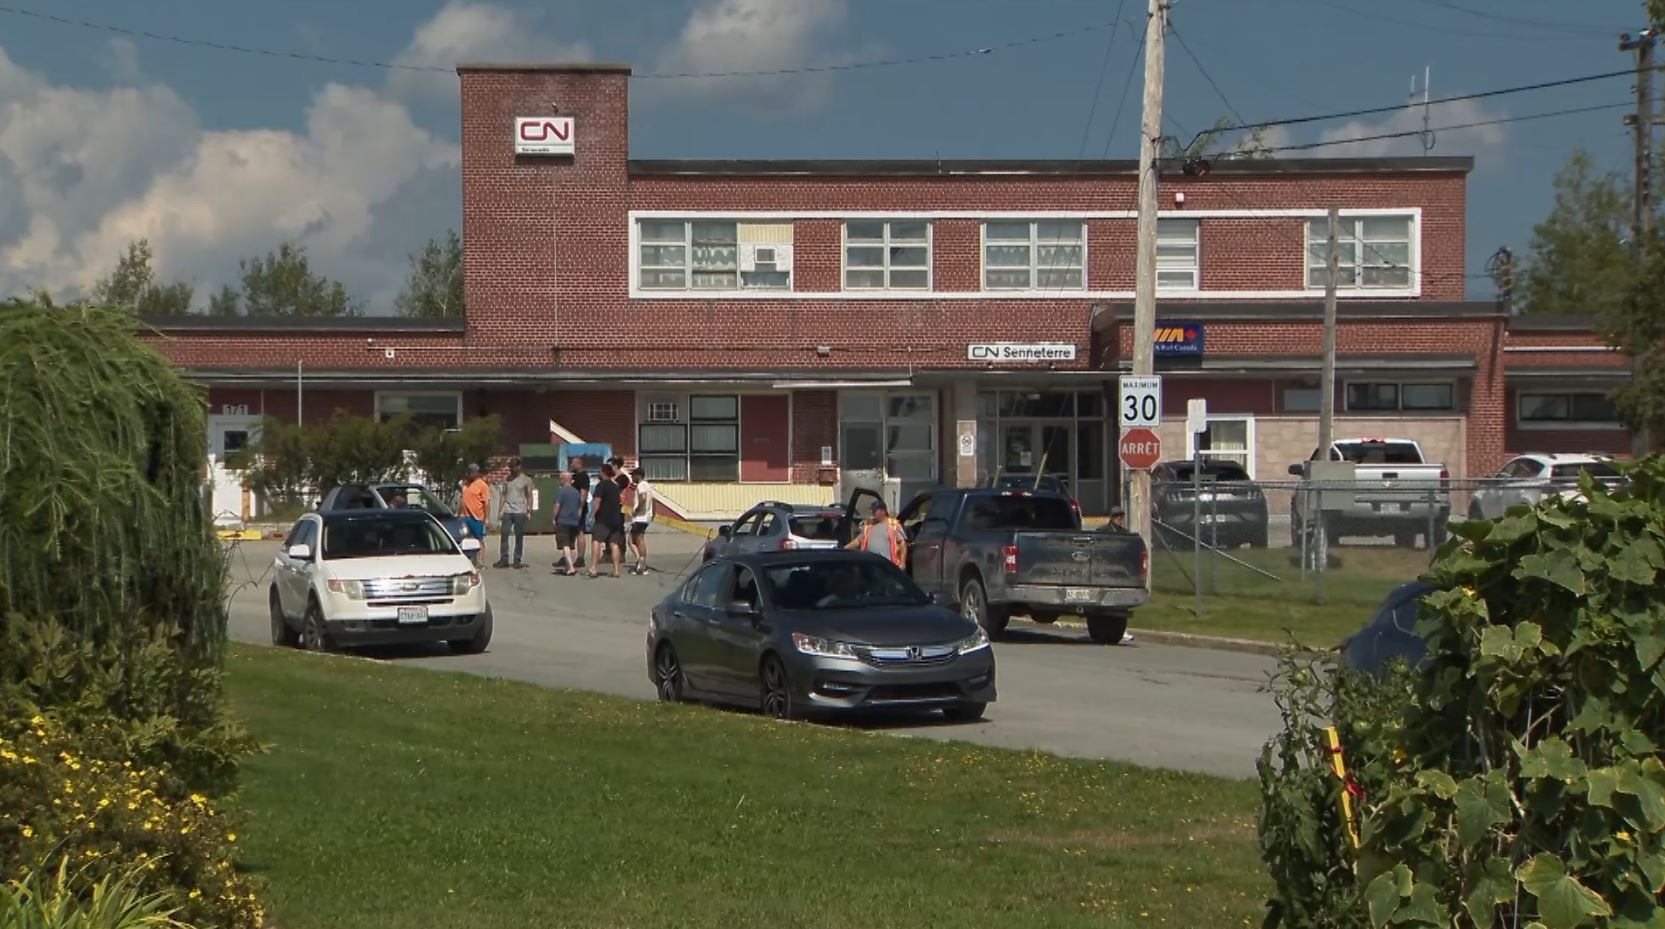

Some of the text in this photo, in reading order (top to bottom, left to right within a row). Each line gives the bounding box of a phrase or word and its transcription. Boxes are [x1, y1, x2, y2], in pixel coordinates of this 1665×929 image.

[520, 121, 569, 141] CN
[972, 346, 1071, 358] CN Senneterre
[1123, 394, 1157, 421] 30
[1121, 441, 1159, 455] ARRÊT
